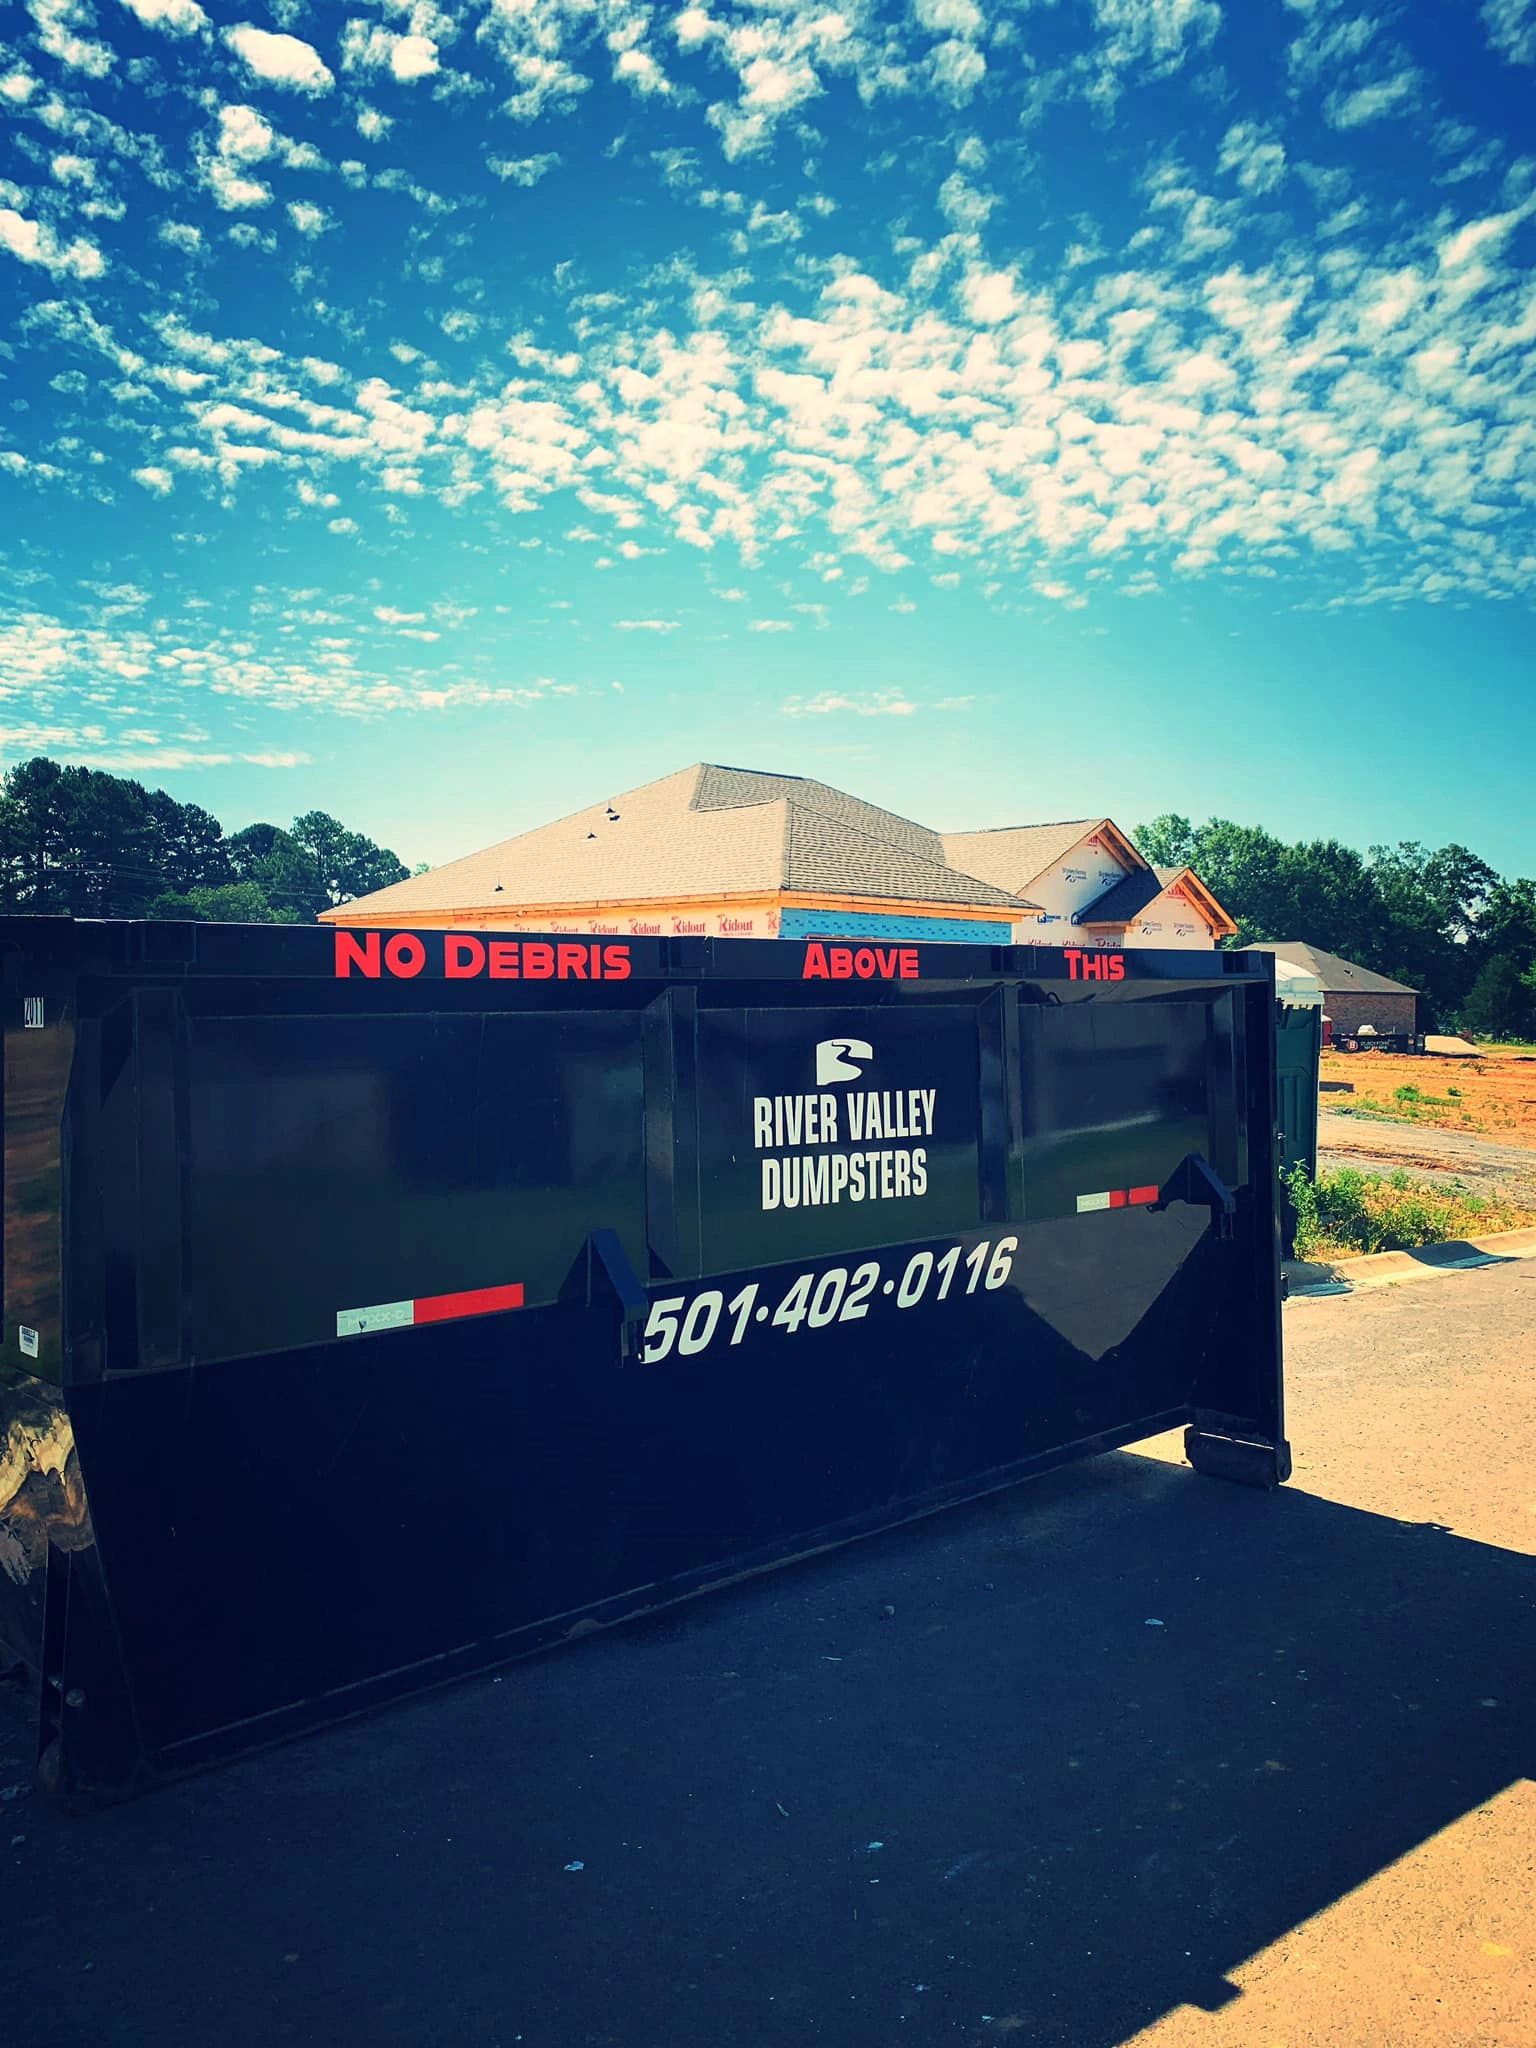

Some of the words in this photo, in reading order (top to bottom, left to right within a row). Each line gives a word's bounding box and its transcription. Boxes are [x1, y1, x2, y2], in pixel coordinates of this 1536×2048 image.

[628, 918, 661, 935] Ridout
[671, 915, 706, 934] Ridout
[717, 913, 753, 932] Ridout
[335, 931, 426, 979] NO
[444, 934, 632, 980] DEBRIS
[802, 943, 919, 979] ABOVE
[1063, 949, 1125, 981] THIS
[753, 1094, 838, 1148] RIVER
[847, 1088, 936, 1141] VALLEY
[761, 1148, 928, 1211] DUMPSTERS
